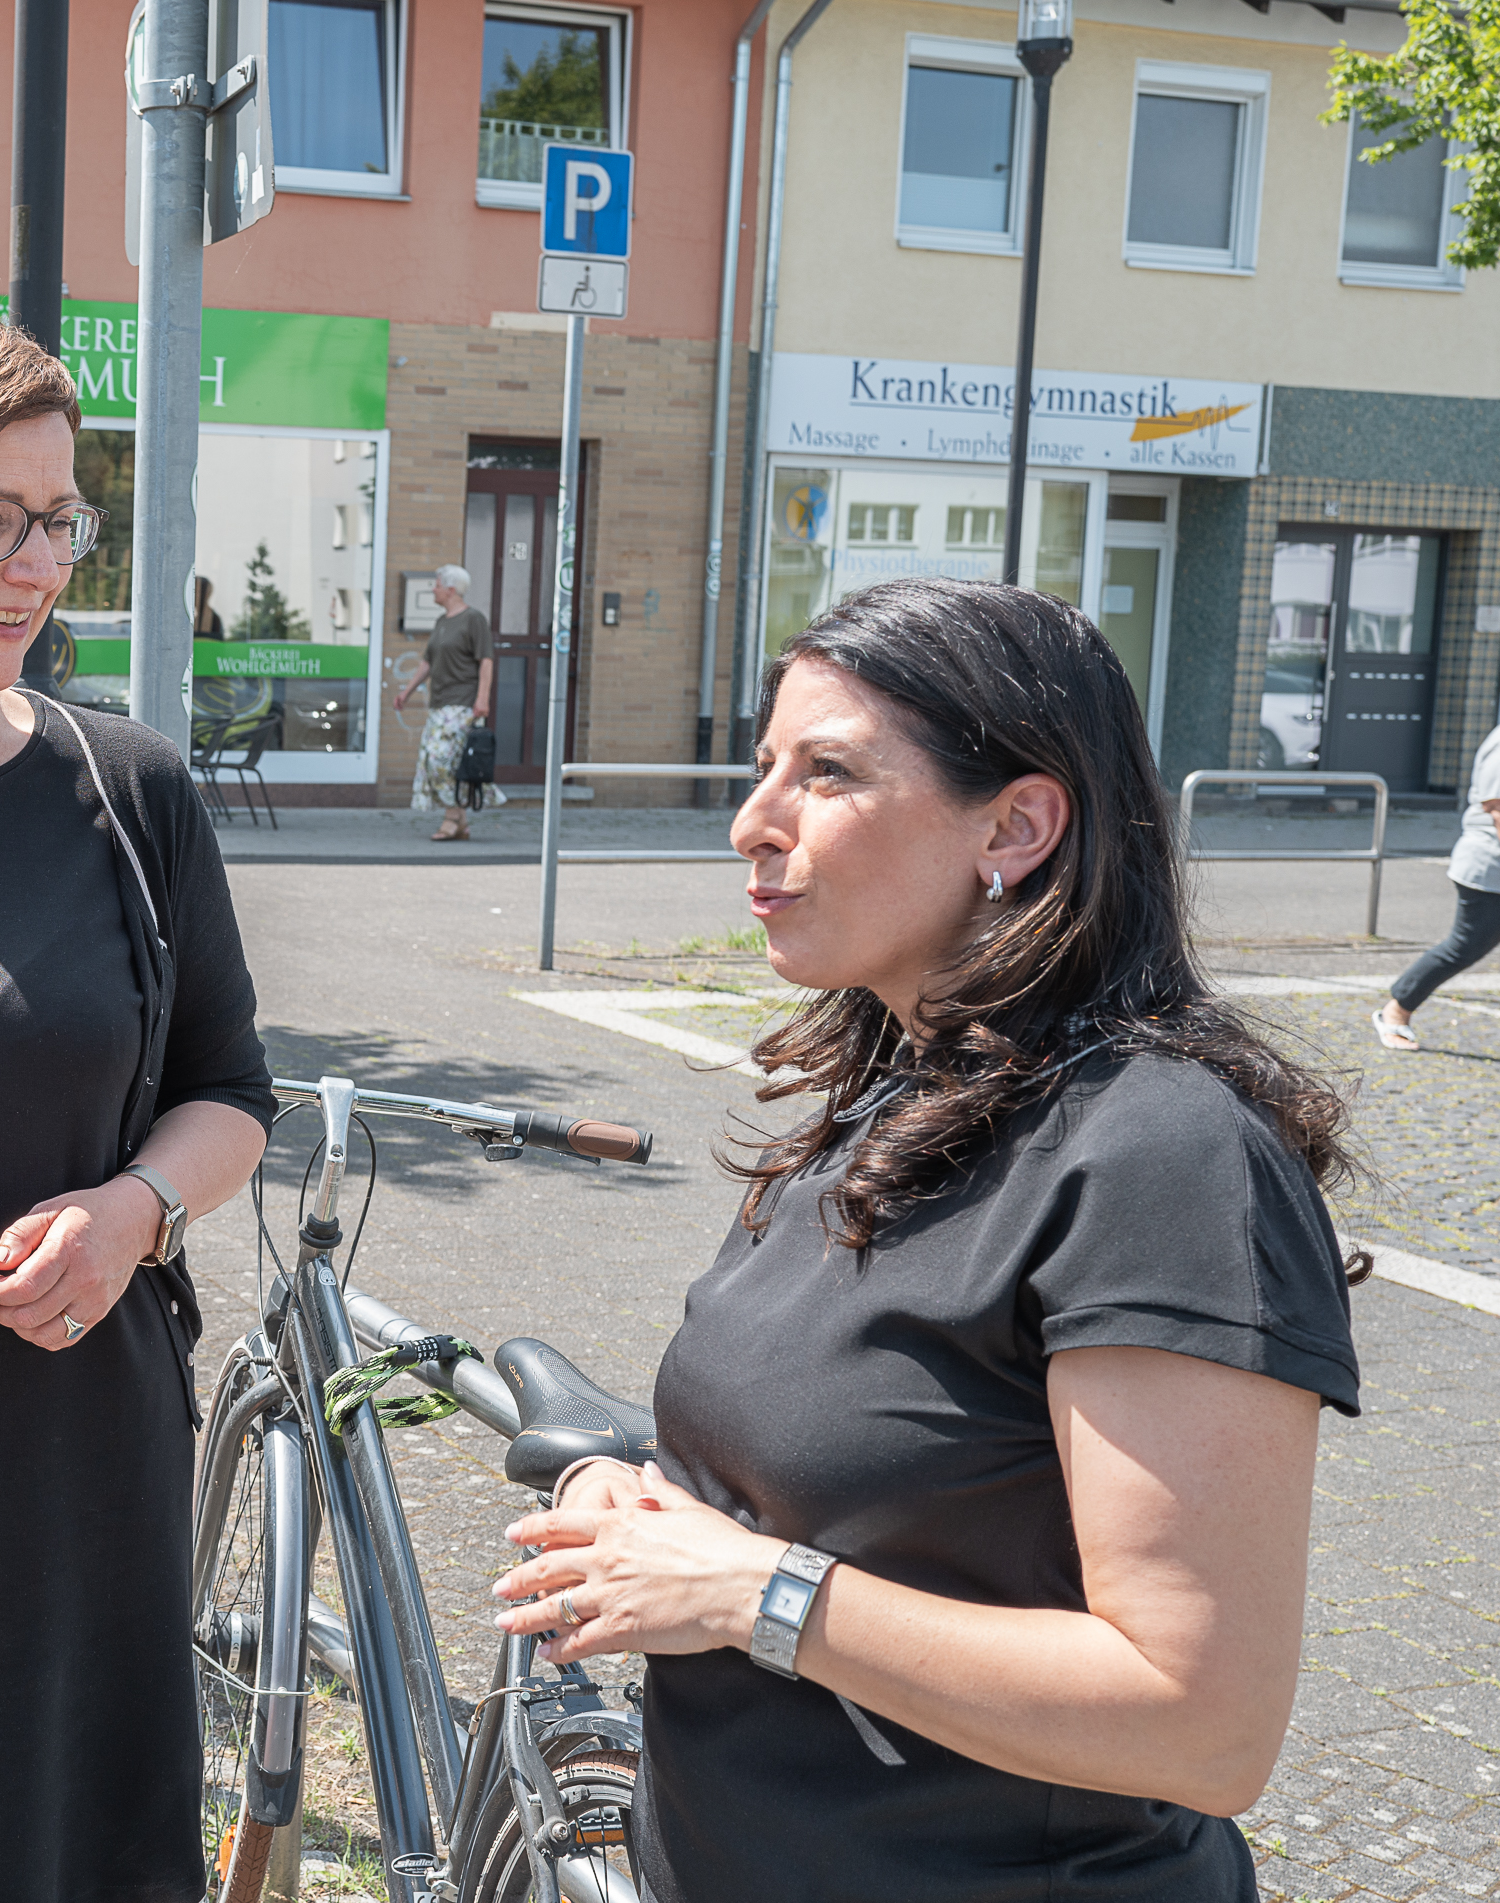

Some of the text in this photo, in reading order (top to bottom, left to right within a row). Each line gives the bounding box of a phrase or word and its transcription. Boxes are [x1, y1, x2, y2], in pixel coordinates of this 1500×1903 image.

[563, 160, 613, 241] P
[850, 360, 1179, 419] Krankengymnastik
[788, 420, 880, 454] Massage
[927, 428, 1085, 464] Lymphdinage
[1130, 440, 1237, 470] alle Kassen
[830, 549, 990, 582] Physiotherapie
[216, 656, 321, 675] WOHLGEMUTH
[249, 646, 300, 661] BÄCKEREI
